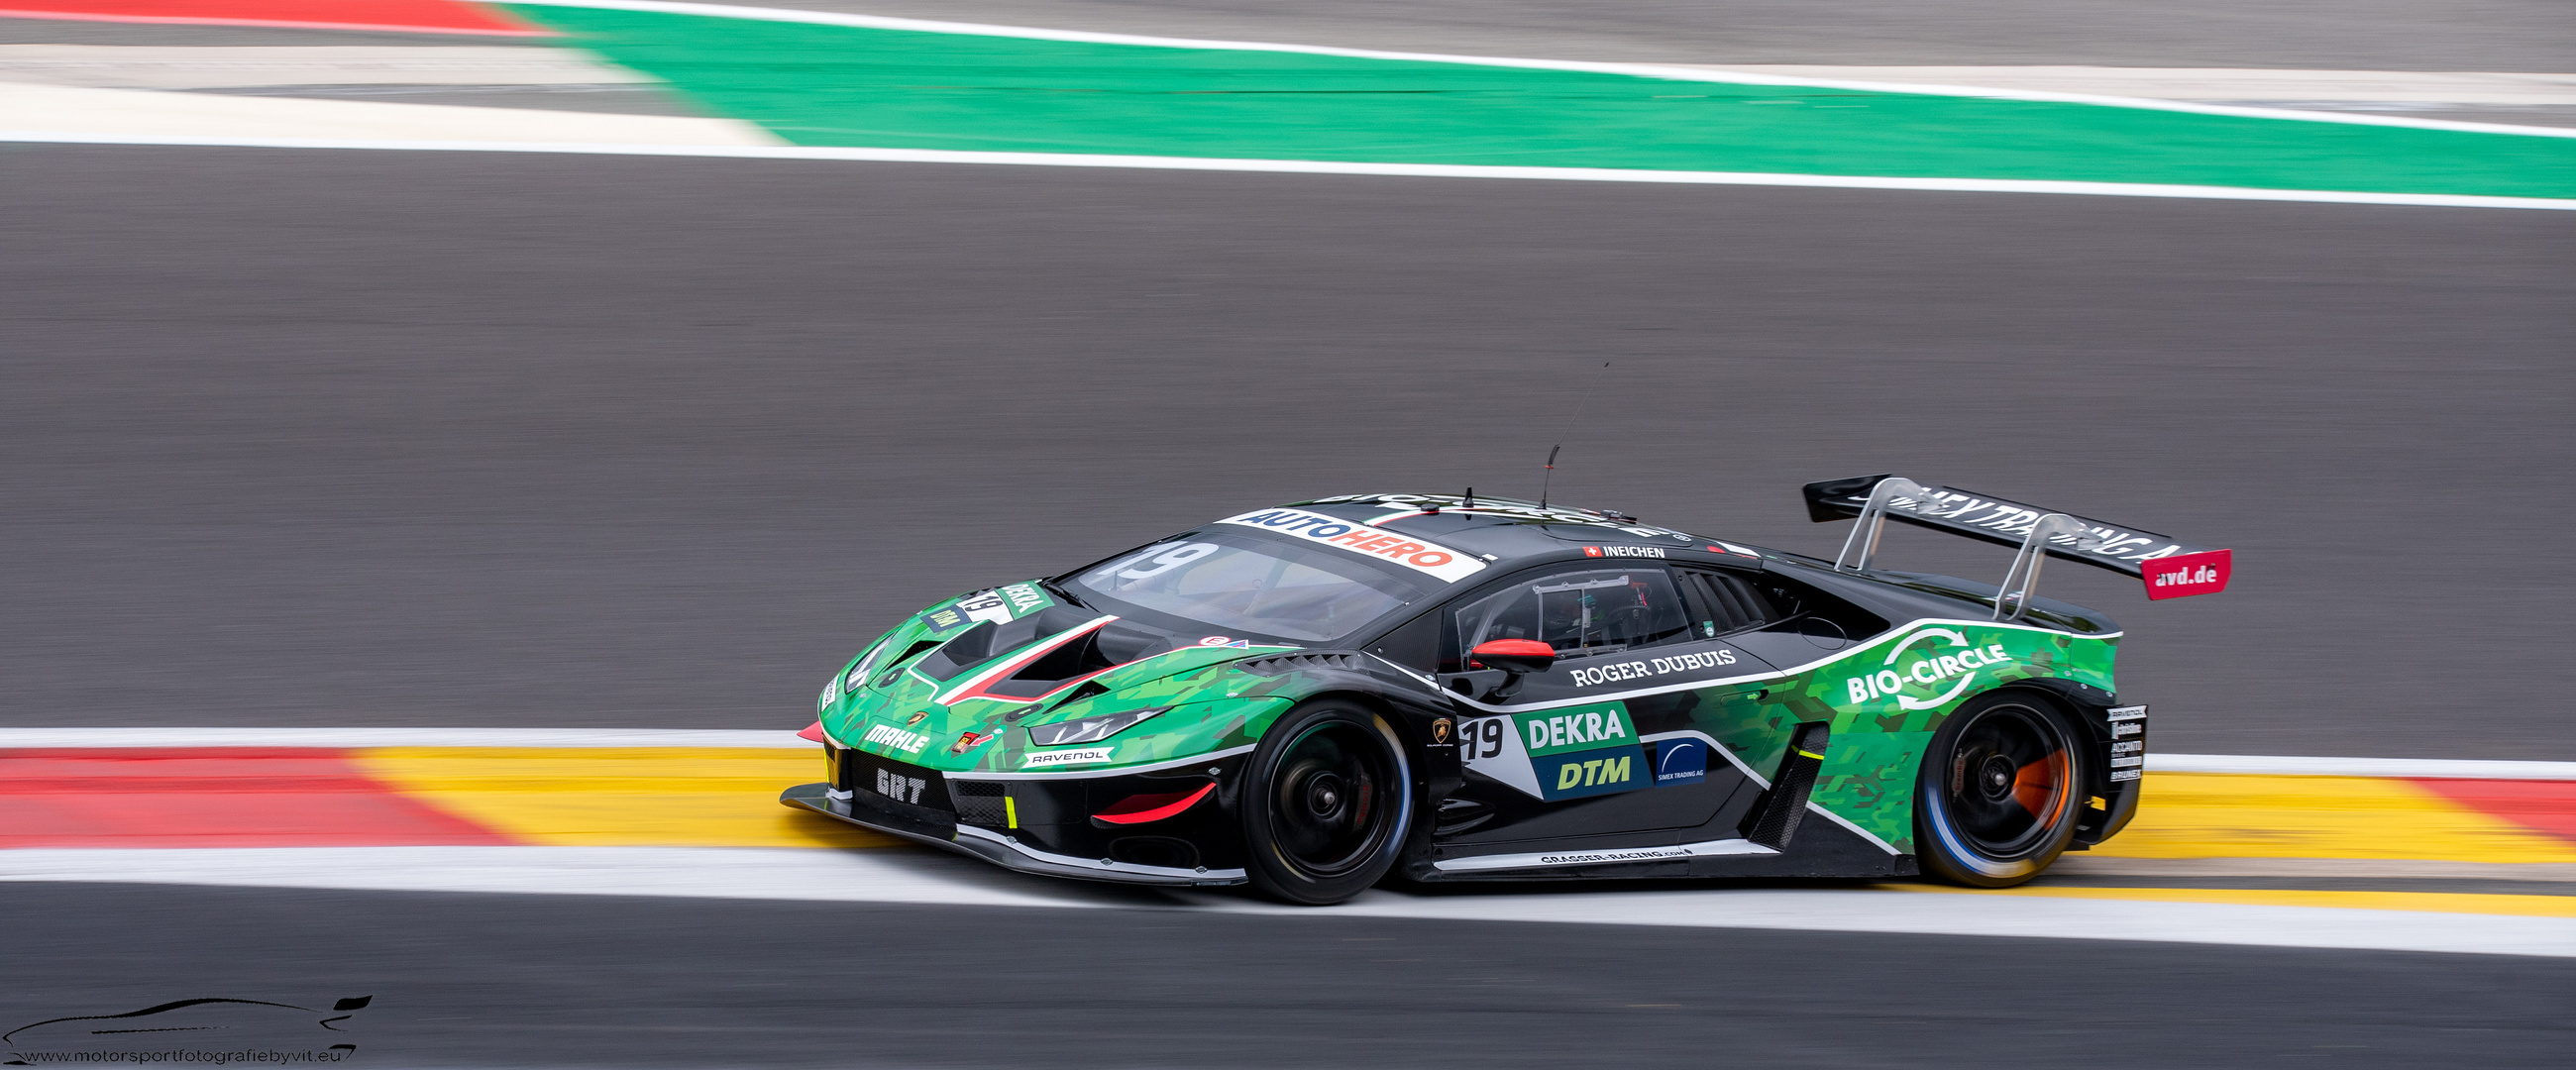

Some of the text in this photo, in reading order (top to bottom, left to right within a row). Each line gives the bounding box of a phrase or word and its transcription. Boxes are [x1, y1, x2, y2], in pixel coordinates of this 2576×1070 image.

[1848, 486, 1996, 518] MEX
[1238, 510, 1452, 567] AUTOHERO
[1602, 545, 1665, 559] INEICHEN
[1096, 541, 1220, 580] 19
[2155, 565, 2217, 587] avd.de
[964, 593, 1004, 612] 19
[1001, 584, 1044, 613] DEKRA
[929, 609, 961, 627] DTM
[1570, 649, 1737, 688] ROGER DUBUIS
[1847, 644, 2013, 704] BIO-CIRCLE
[864, 723, 930, 754] MAHLE
[1461, 718, 1503, 760] 19
[1529, 709, 1626, 749] DEKRA
[1032, 751, 1104, 763] RAVENOL
[1556, 756, 1631, 791] DTM
[876, 767, 926, 804] GRT
